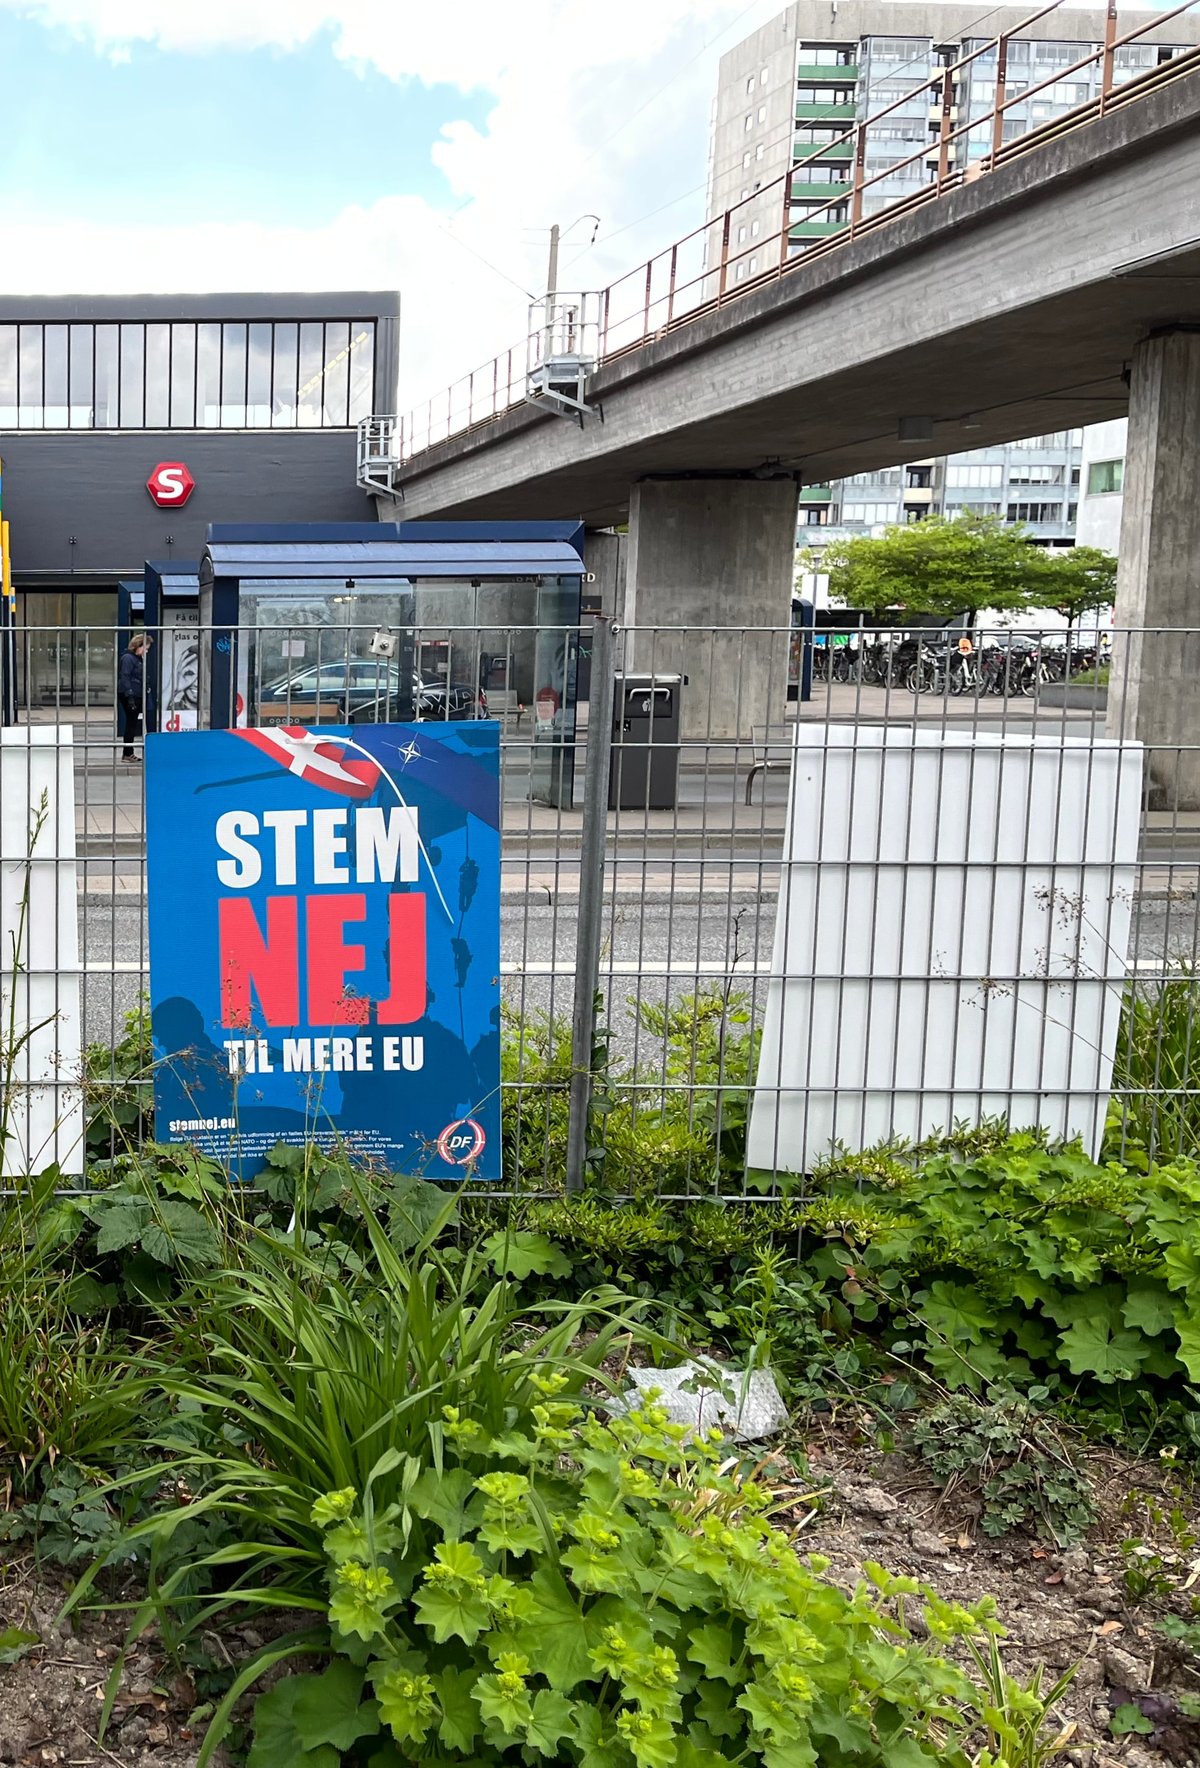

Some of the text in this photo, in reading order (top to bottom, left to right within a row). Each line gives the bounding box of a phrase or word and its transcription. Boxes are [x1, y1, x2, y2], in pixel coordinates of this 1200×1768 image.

[156, 468, 184, 499] S
[215, 806, 419, 889] STEM
[217, 892, 427, 1029] NEJ
[223, 1036, 424, 1074] TIL MERE EU
[169, 1117, 236, 1131] stemnej.eu
[450, 1135, 473, 1149] DF
